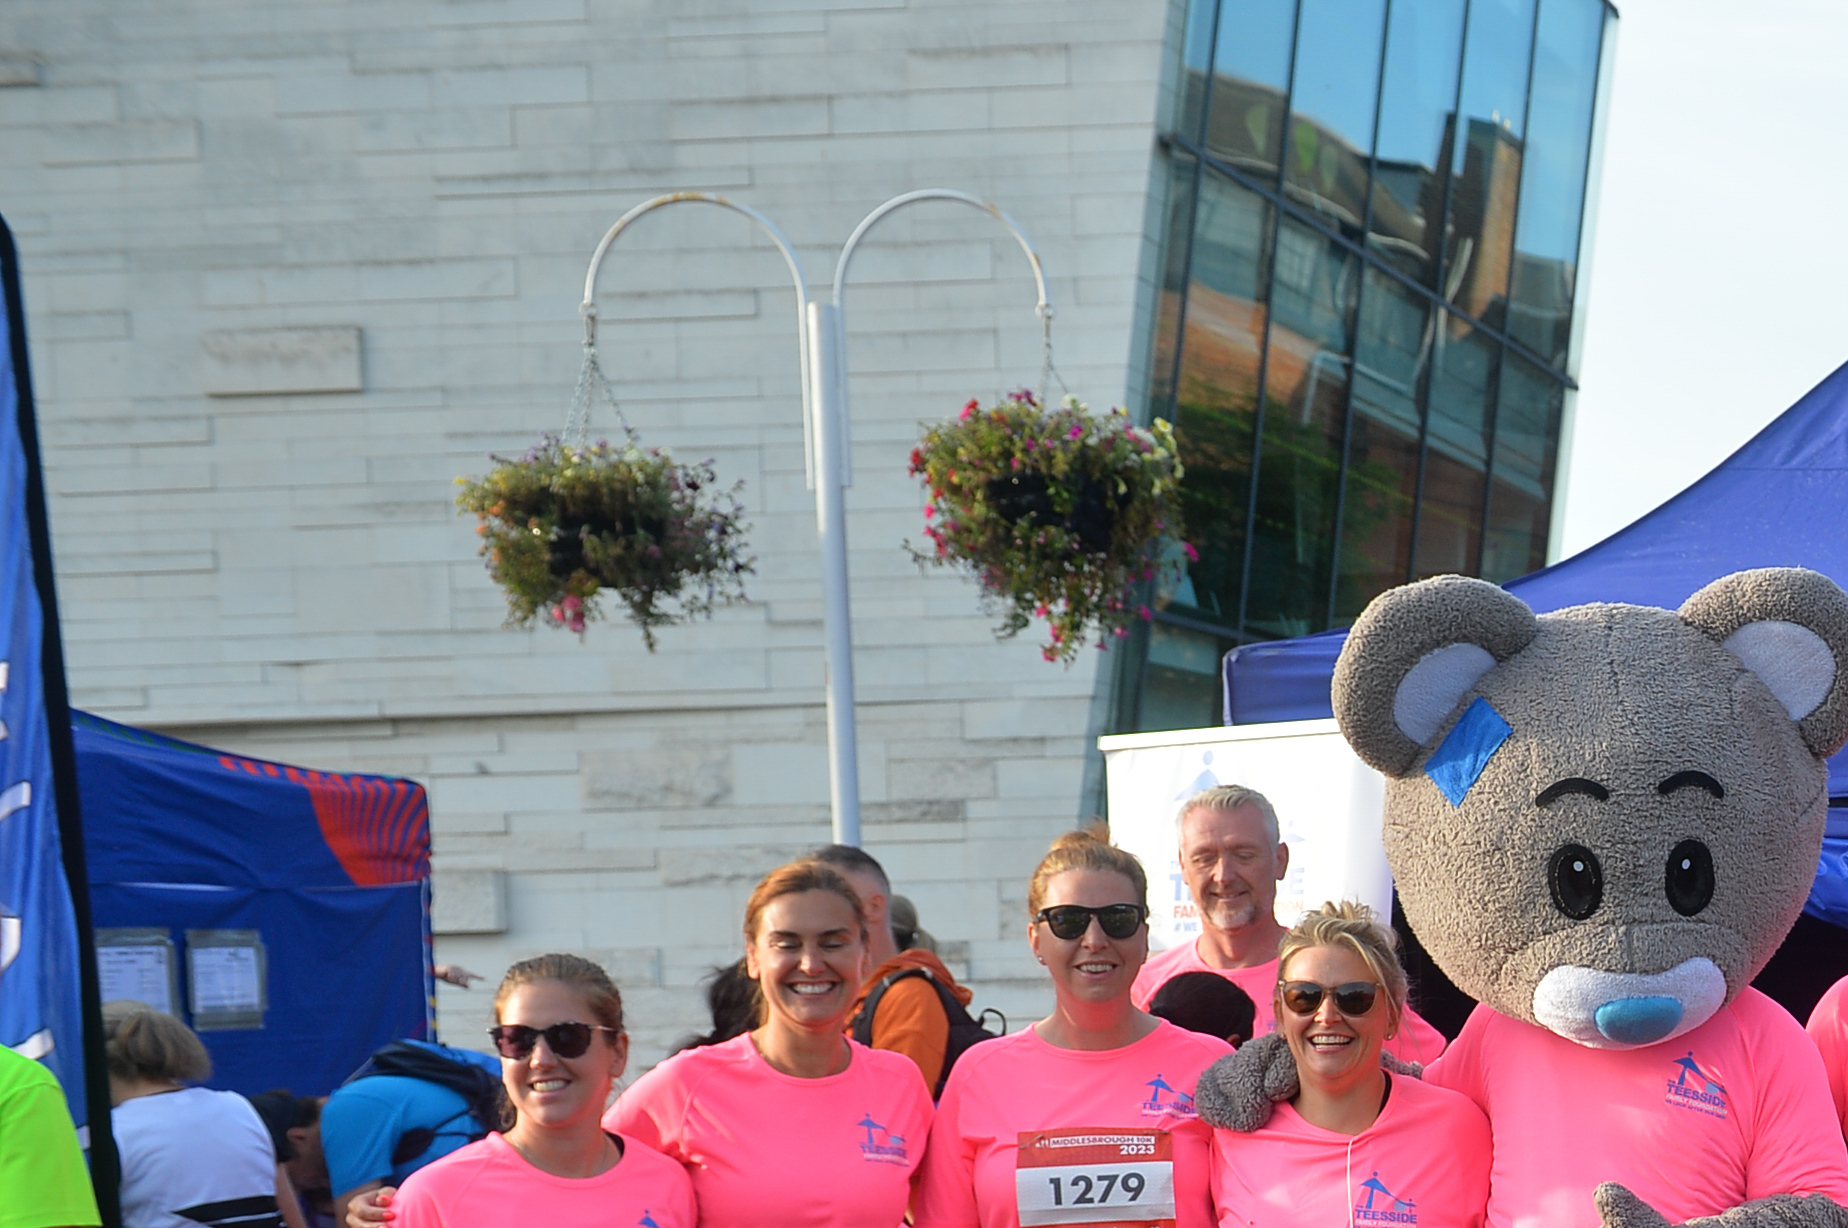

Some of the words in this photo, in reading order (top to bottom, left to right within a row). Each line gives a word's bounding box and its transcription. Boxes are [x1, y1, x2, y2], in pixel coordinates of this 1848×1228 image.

[1184, 922, 1198, 931] WE
[1052, 1136, 1135, 1147] MIDDLESBROUGH
[1136, 1136, 1152, 1144] 10K
[1119, 1145, 1155, 1155] 2023
[1049, 1172, 1145, 1206] 1279
[1355, 1208, 1418, 1224] TEESSIDE
